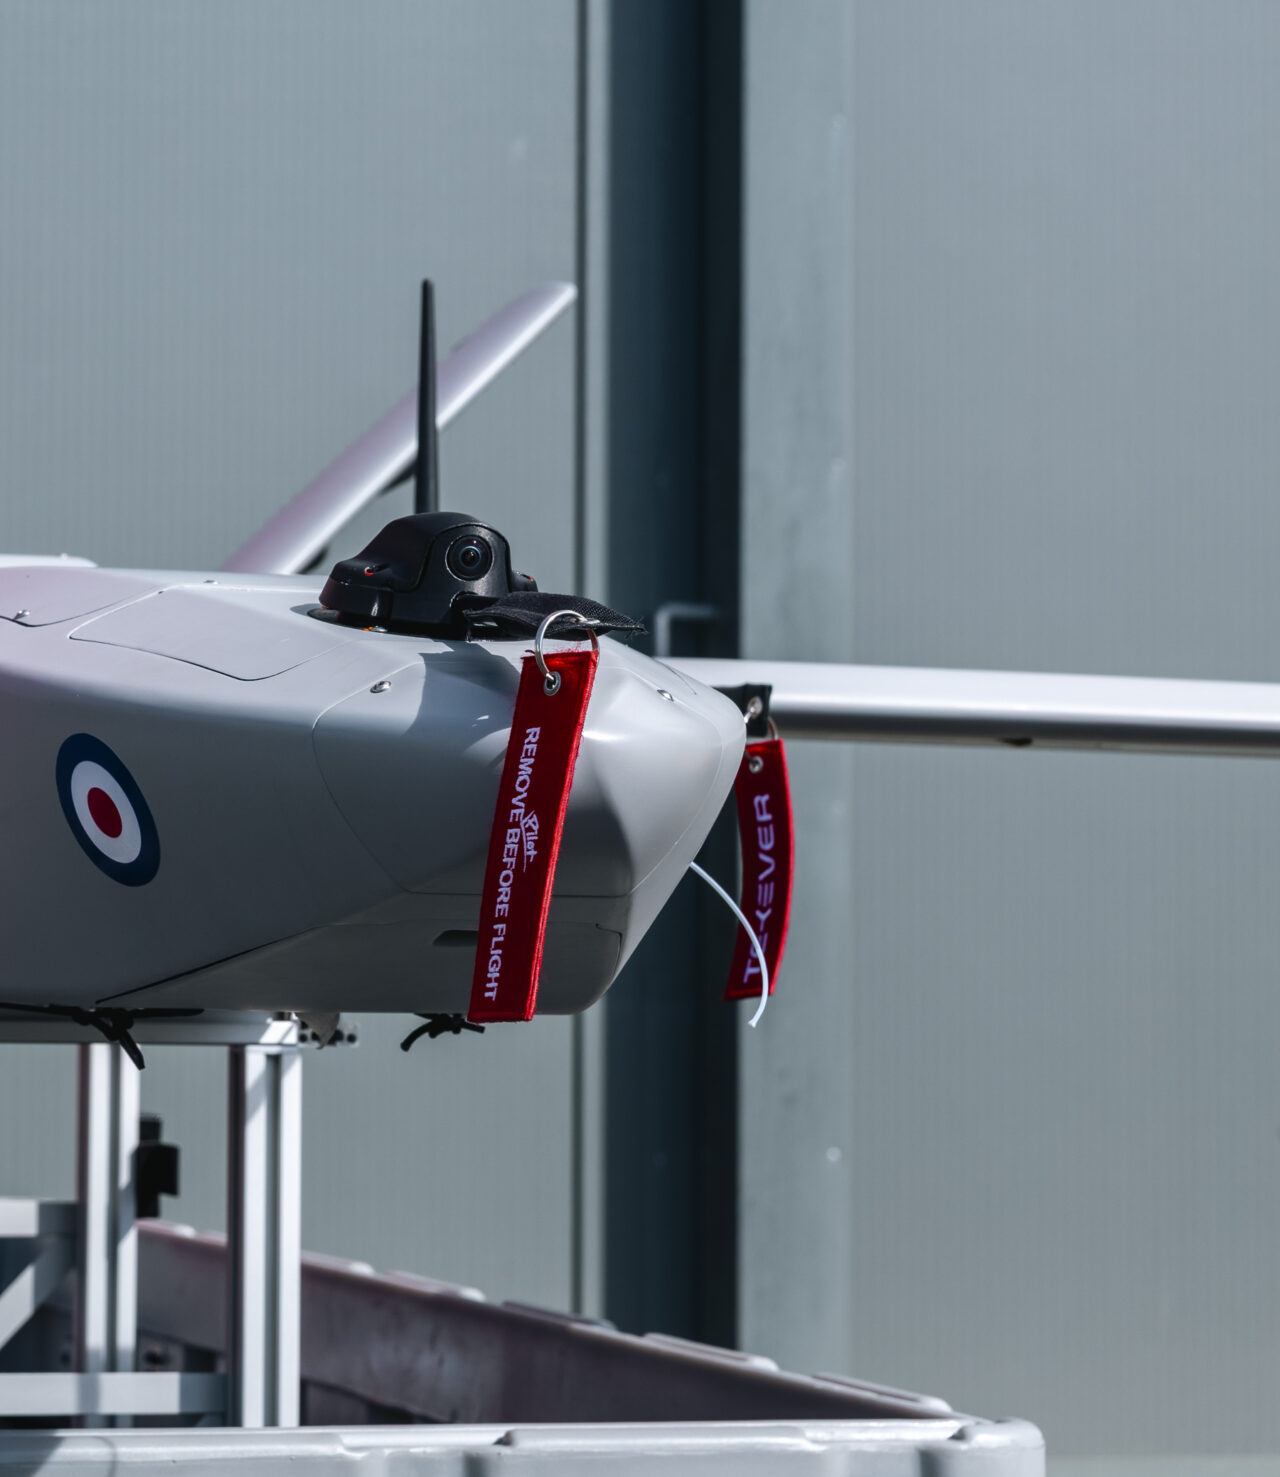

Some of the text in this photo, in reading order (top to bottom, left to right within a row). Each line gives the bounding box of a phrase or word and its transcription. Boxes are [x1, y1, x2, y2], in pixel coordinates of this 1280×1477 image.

[484, 726, 541, 1001] REMOVE BEFORE FLIGHT
